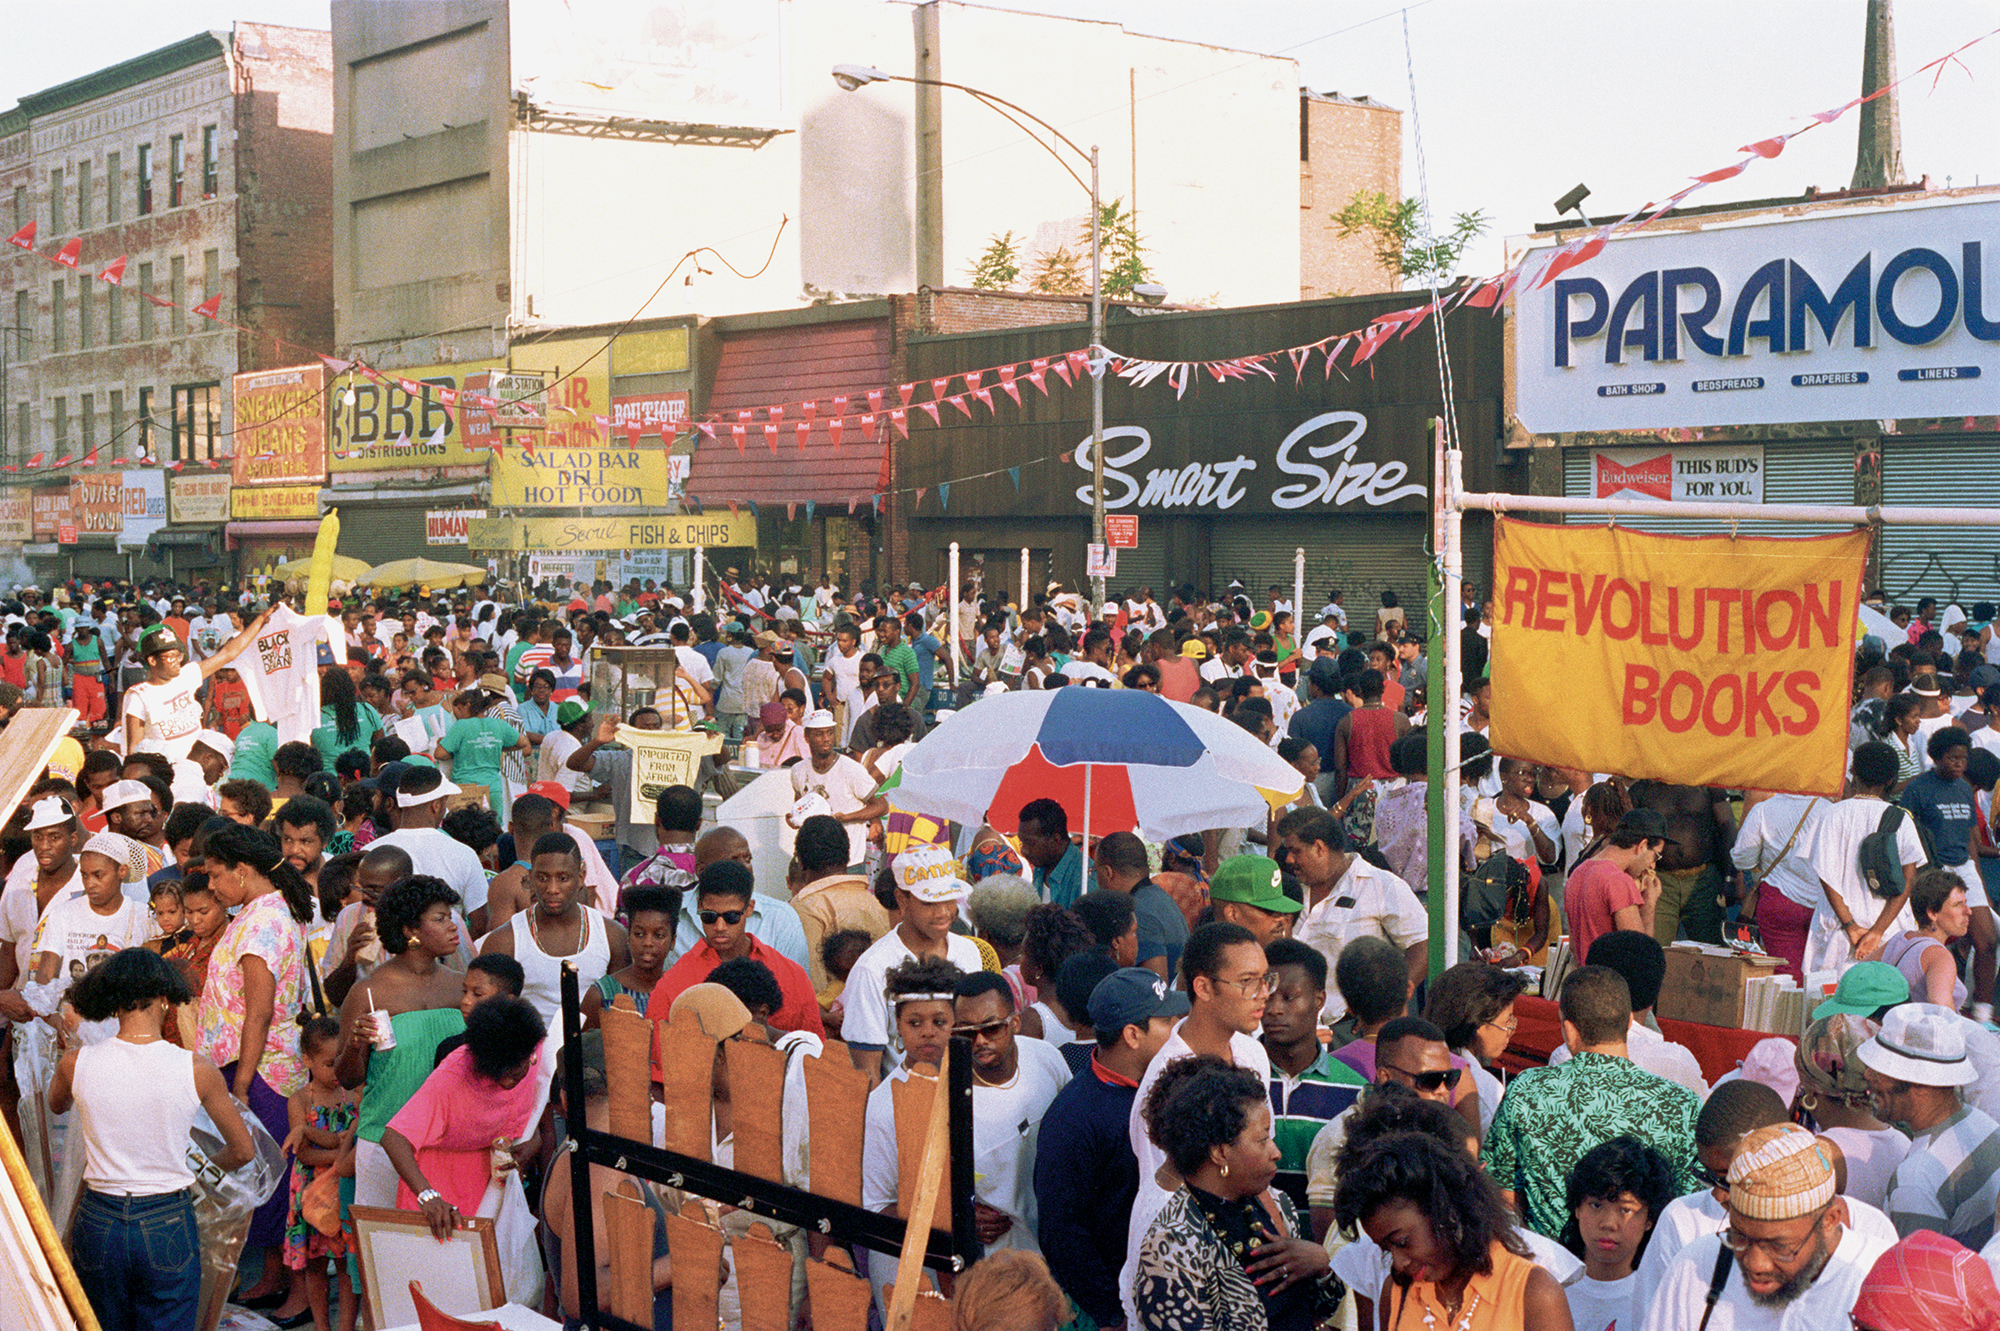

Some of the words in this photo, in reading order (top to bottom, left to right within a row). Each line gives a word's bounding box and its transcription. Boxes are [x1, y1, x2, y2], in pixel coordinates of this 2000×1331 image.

[1801, 371, 1858, 385] DRAPERIES
[1917, 367, 1958, 380] LINENS
[515, 377, 545, 391] STATION
[1606, 384, 1628, 396] BATH
[1632, 383, 1657, 395] SHOP
[1697, 377, 1760, 391] BEDSPREADS
[441, 389, 455, 400] Bud
[548, 377, 591, 409] AIR
[236, 390, 320, 424] SNEAKERS
[614, 400, 686, 427] BOUTIQUE
[861, 415, 874, 423] Bud
[891, 410, 904, 419] Bud
[468, 423, 491, 435] WEAR
[628, 421, 641, 429] Bud
[662, 424, 675, 432] Bud
[732, 425, 745, 433] Bud
[765, 424, 777, 432] Bud
[798, 422, 810, 430] Bud
[829, 419, 842, 427] Bud
[247, 425, 307, 457] JEANS
[358, 443, 447, 459] DISTRIBUTORS
[522, 451, 593, 468] SALAD
[599, 452, 641, 469] BAR
[1074, 426, 1257, 510] Smart
[1271, 411, 1427, 509] Size
[1677, 460, 1712, 474] THIS
[1716, 458, 1759, 474] BUD'S
[558, 470, 604, 485] DELI
[1601, 470, 1669, 484] Budweiser
[81, 480, 124, 504] buster
[525, 487, 568, 502] HOT
[578, 487, 636, 502] FOOD
[1686, 482, 1715, 496] FOR
[1720, 481, 1752, 496] YOU.
[125, 487, 146, 514] RED
[263, 492, 316, 506] SNEAKER
[85, 508, 124, 530] brown
[630, 525, 665, 544] FISH
[669, 528, 681, 543] &
[687, 524, 729, 544] CHIPS
[1502, 566, 1842, 655] REVOLUTION
[258, 632, 290, 653] BLACK
[1622, 663, 1821, 738] BOOKS
[640, 750, 689, 762] IMPORTED
[650, 762, 675, 772] FROM
[646, 772, 678, 782] AFRICA
